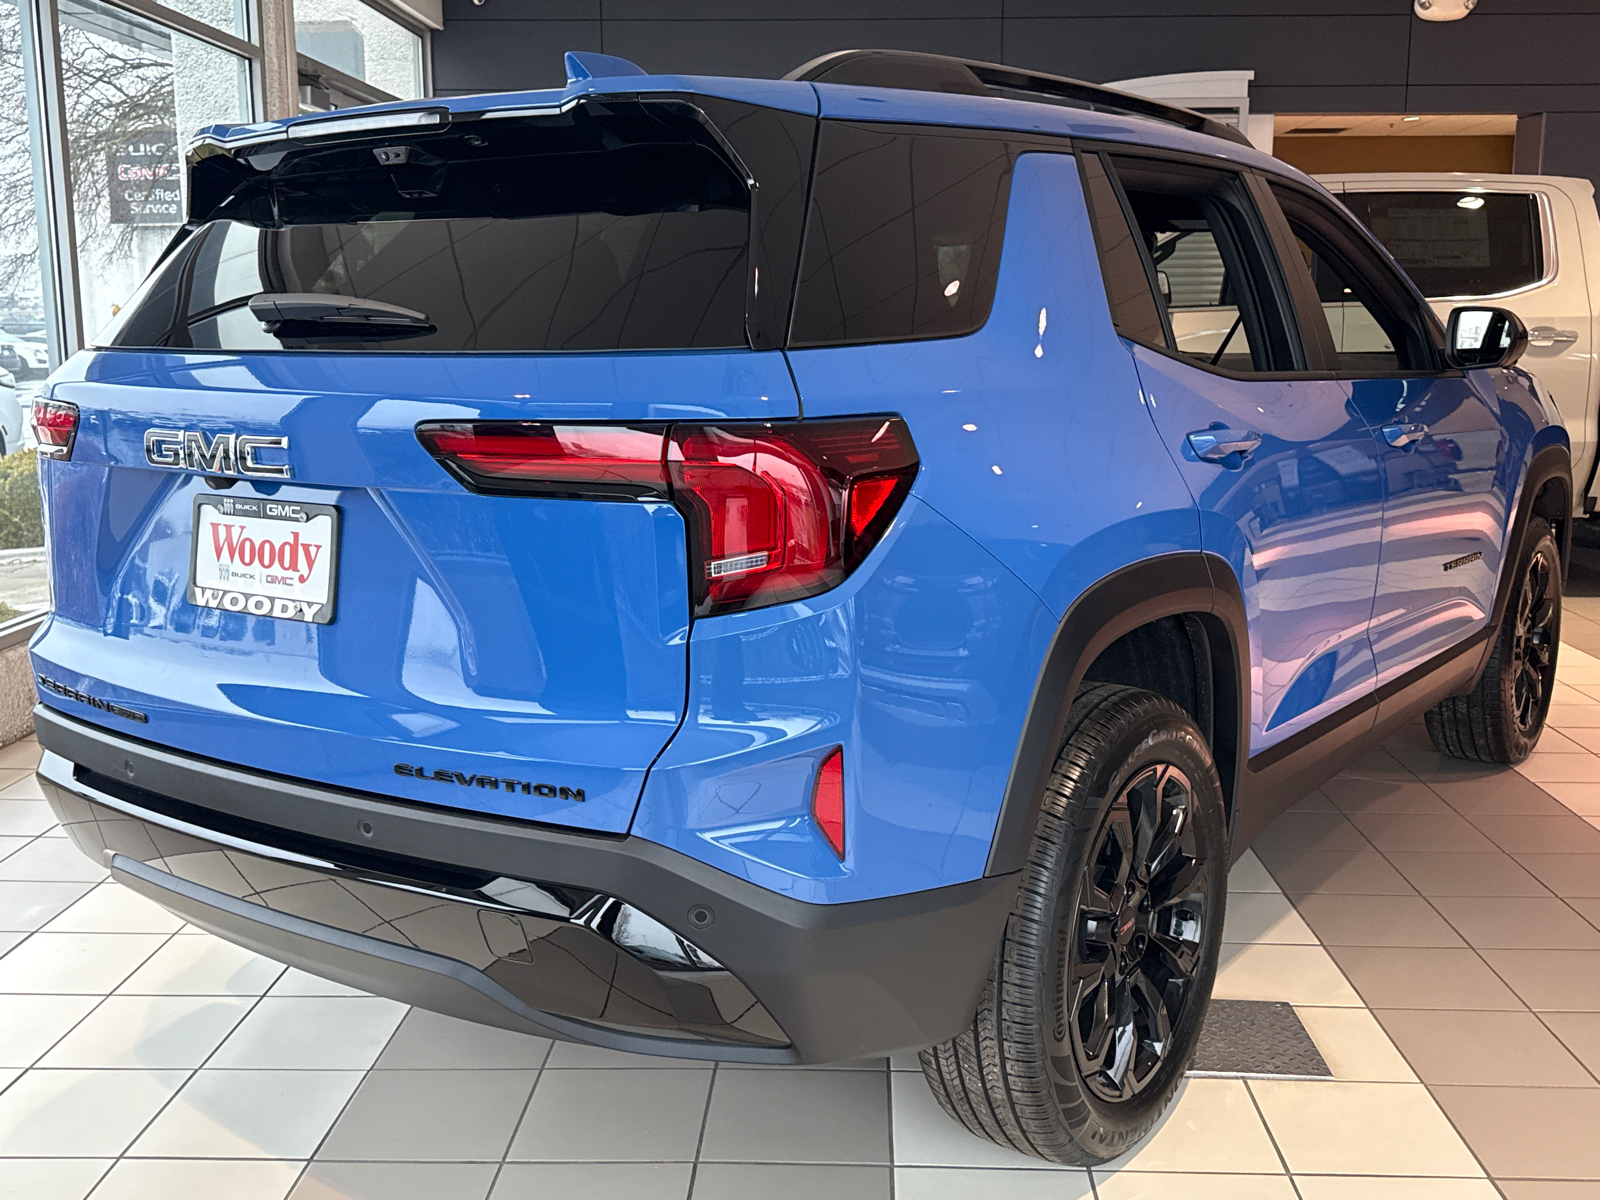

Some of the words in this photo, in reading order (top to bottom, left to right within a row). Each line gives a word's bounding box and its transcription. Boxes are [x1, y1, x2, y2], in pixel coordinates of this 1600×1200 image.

[144, 428, 292, 478] GMC
[235, 503, 258, 511] BUICK
[266, 504, 302, 518] GMC
[209, 522, 322, 583] Woody
[231, 571, 256, 580] BUICK
[265, 574, 294, 587] GMC
[194, 586, 324, 623] WOODY
[393, 762, 586, 803] ELEVATION
